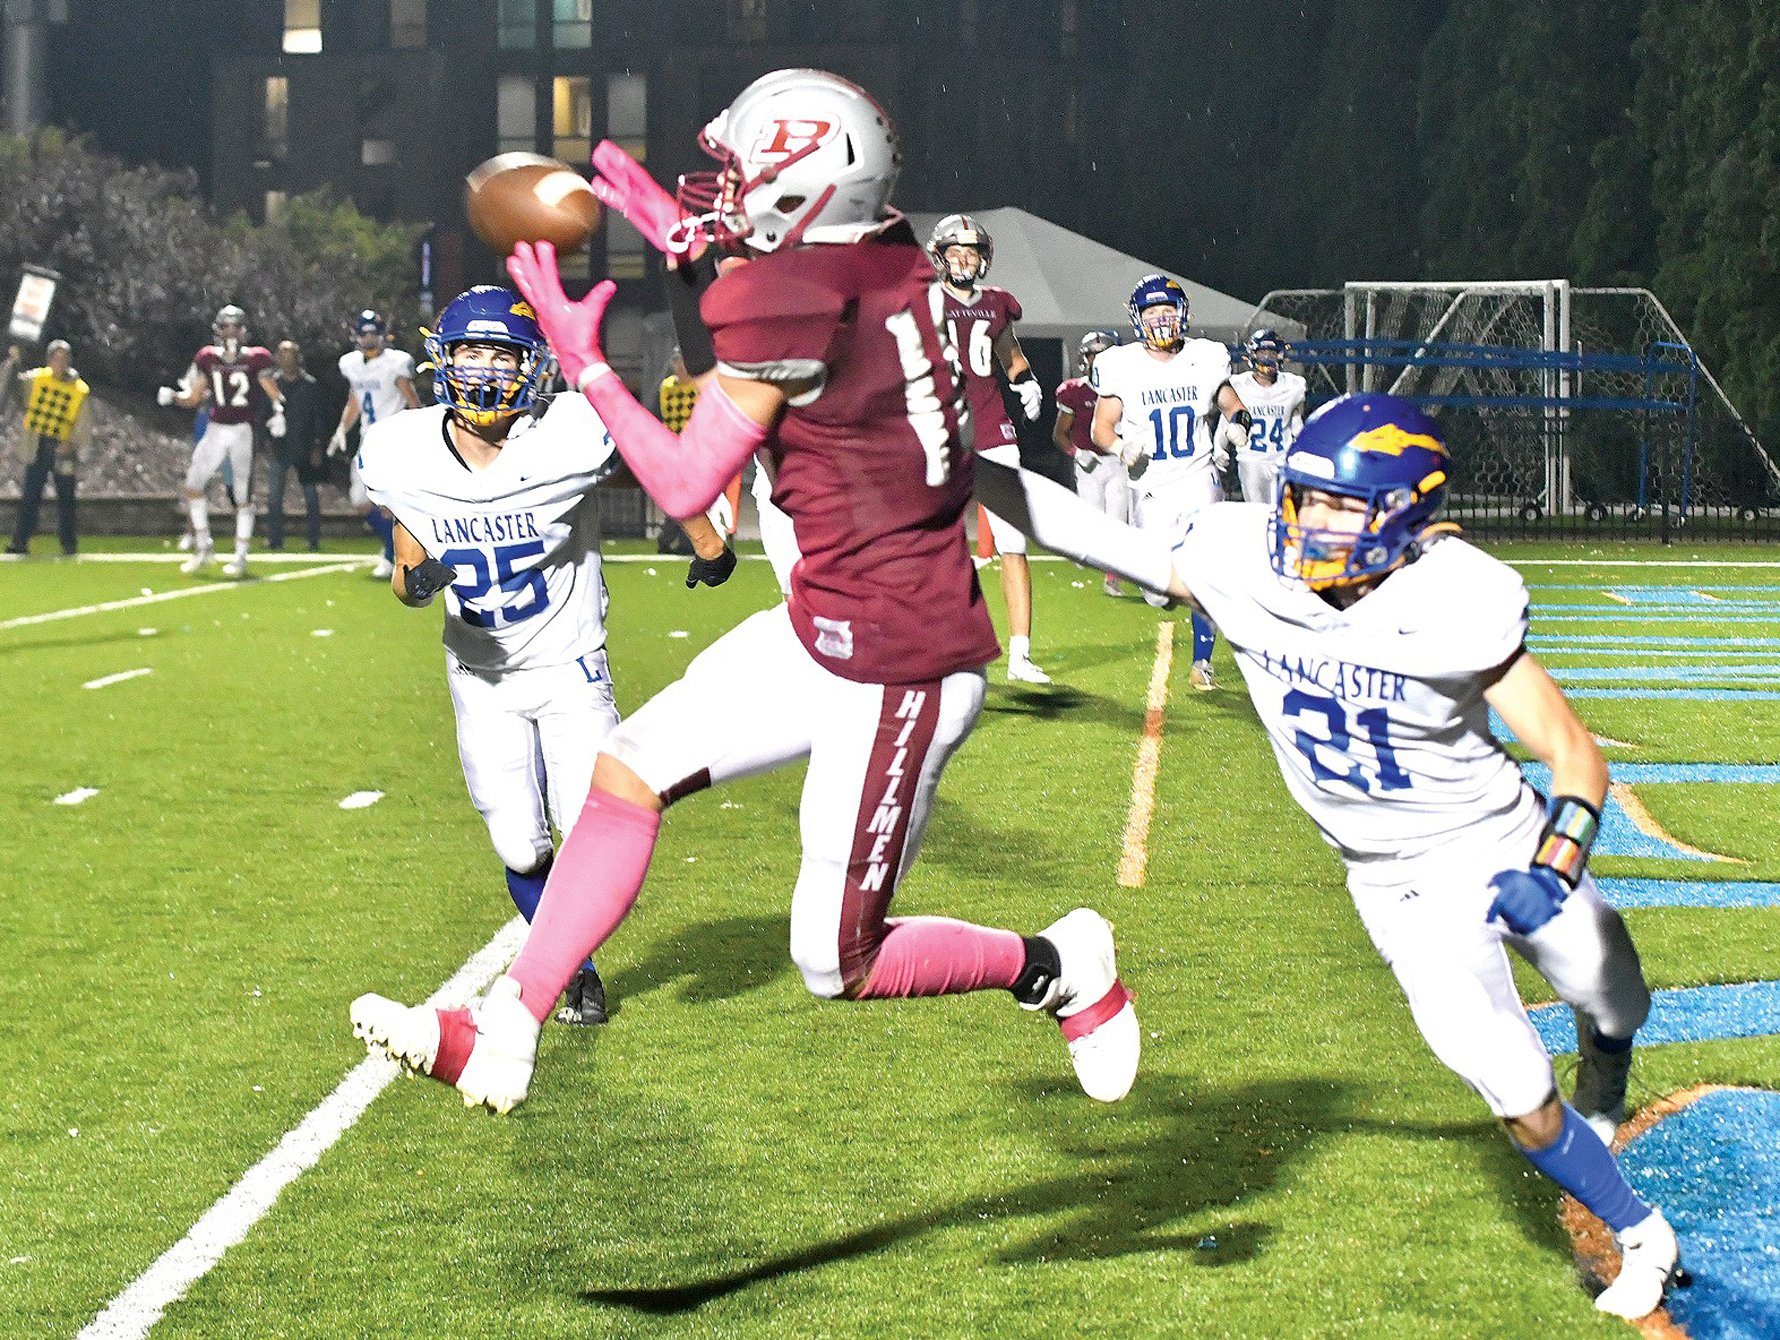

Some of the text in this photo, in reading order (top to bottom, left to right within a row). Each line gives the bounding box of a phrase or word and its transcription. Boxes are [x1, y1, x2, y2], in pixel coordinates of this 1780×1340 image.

[761, 119, 831, 153] P
[946, 309, 997, 319] ATTEVILLE
[212, 370, 250, 407] 12
[1141, 385, 1198, 406] LANCASTER
[362, 391, 377, 425] 4
[1148, 405, 1196, 461] 10
[1250, 417, 1285, 453] 24
[431, 511, 541, 544] LANCASTER
[439, 539, 550, 629] 25
[575, 655, 602, 684] L
[1263, 649, 1407, 702] LANCASTER
[1282, 687, 1414, 793] 21
[858, 689, 927, 892] HILLMEN
